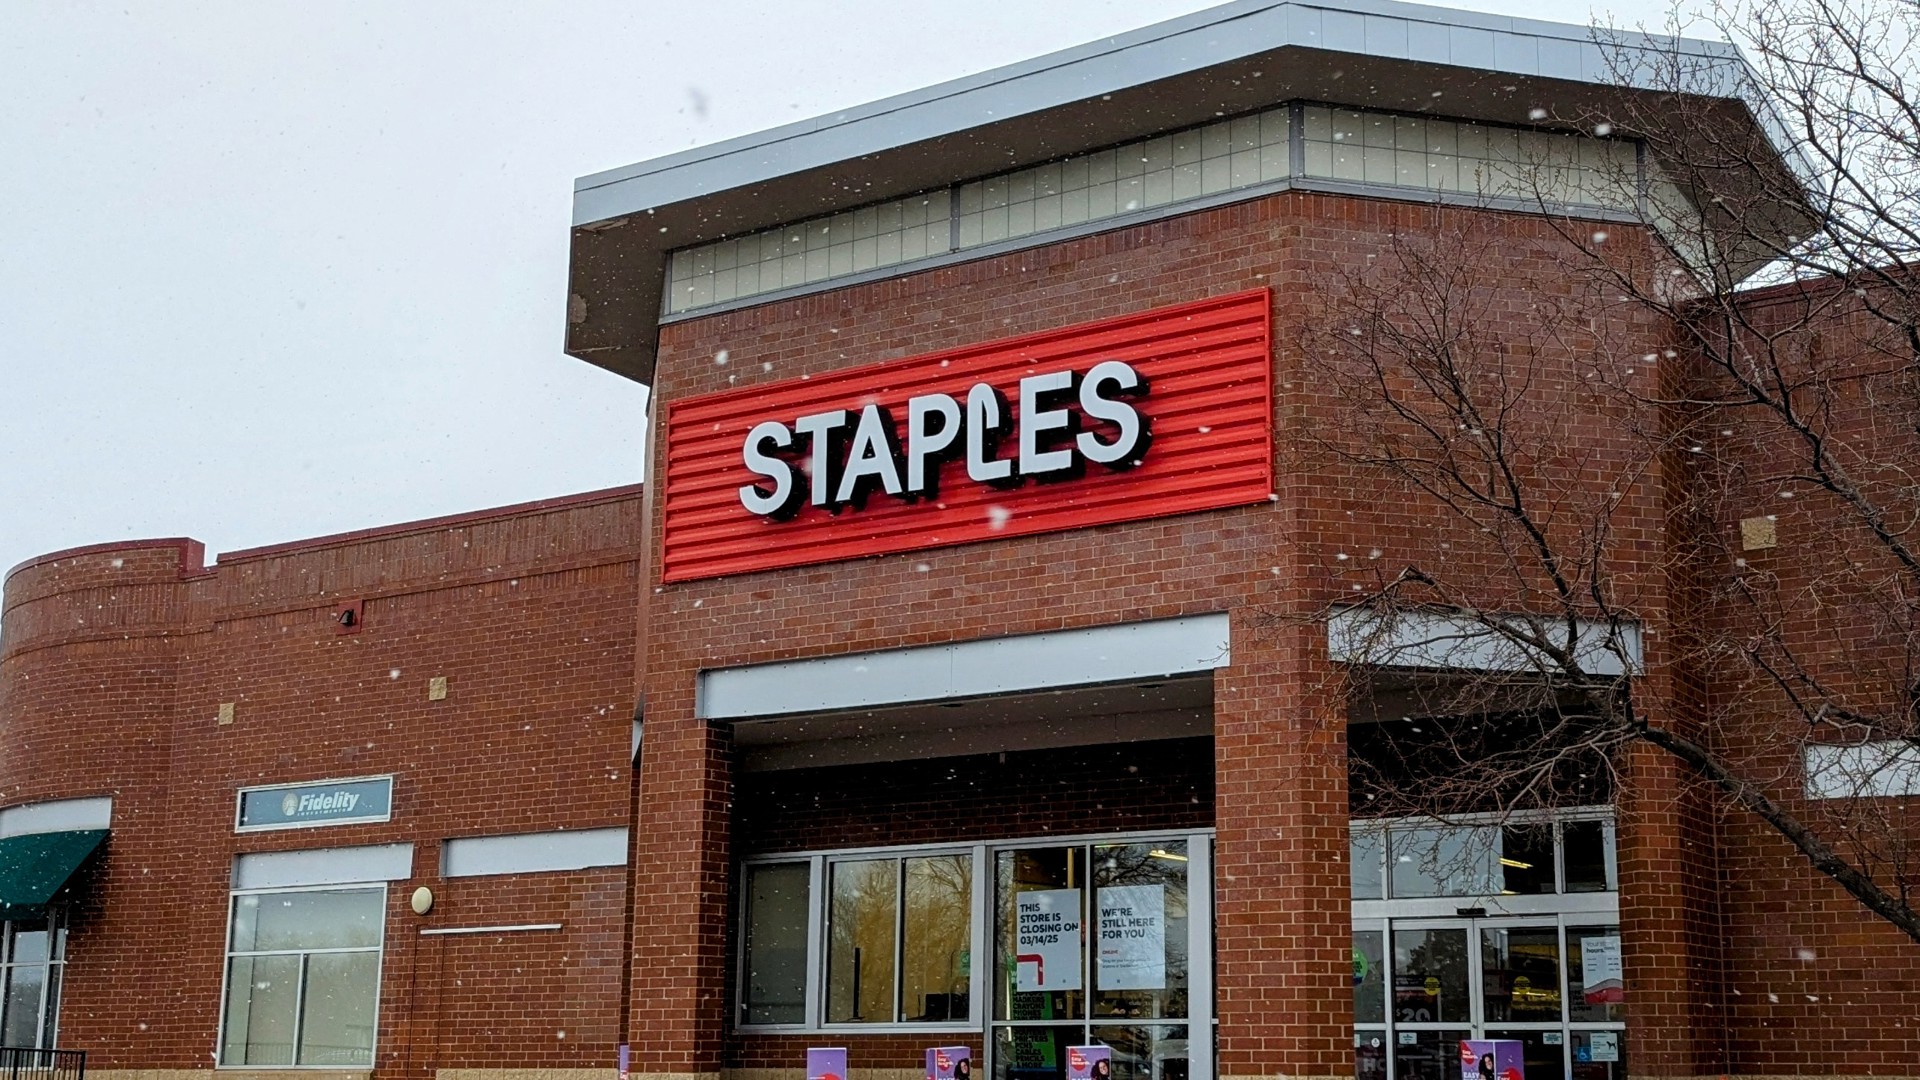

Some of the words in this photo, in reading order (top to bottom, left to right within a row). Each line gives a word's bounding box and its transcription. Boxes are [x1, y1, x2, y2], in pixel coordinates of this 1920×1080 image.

[739, 361, 1141, 514] STAPLES
[298, 791, 360, 812] Fidelity
[1020, 903, 1040, 912] THIS
[1101, 907, 1133, 917] WE'RE
[1020, 913, 1050, 923] STORE
[1052, 913, 1061, 922] IS
[1102, 918, 1127, 928] STILL
[1129, 917, 1155, 927] HERE
[1020, 924, 1062, 934] CLOSING
[1064, 922, 1078, 931] ON
[1102, 930, 1122, 939] FOR
[1124, 928, 1145, 938] YOU
[1020, 934, 1059, 946] 03/14/25
